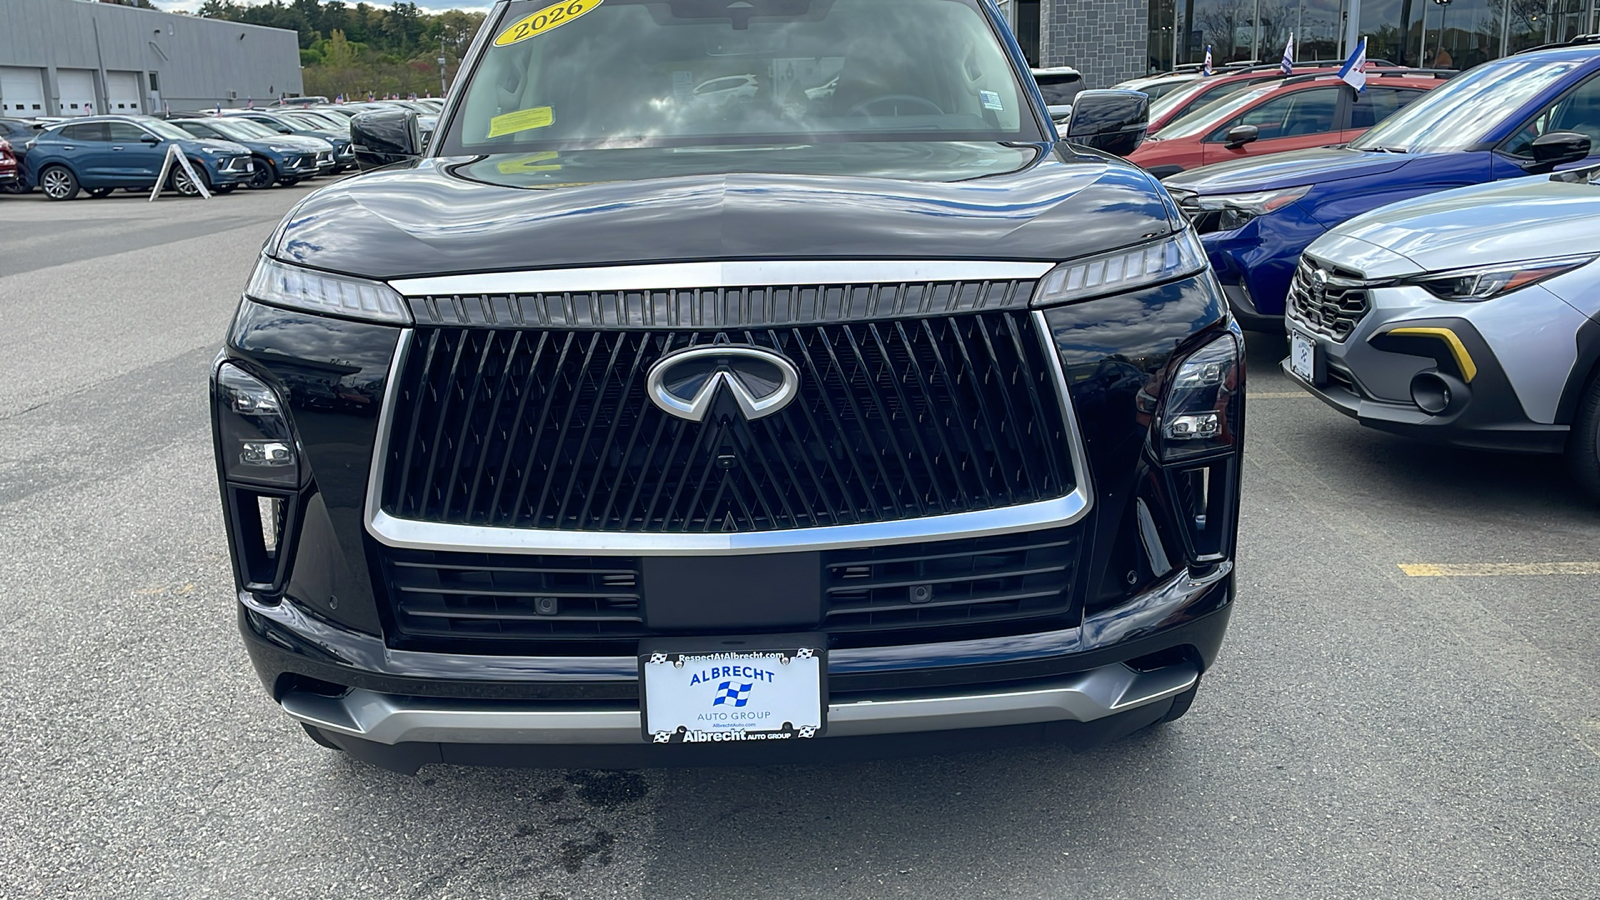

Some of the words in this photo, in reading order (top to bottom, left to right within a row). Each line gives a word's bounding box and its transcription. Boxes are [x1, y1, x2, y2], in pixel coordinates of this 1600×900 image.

[514, 0, 583, 40] 2026
[678, 651, 785, 662] RespectAtAlbrecht.com
[690, 665, 775, 686] ALBRECHT
[697, 712, 728, 721] AUTO
[731, 711, 771, 720] GROUP
[682, 727, 747, 743] Albrecht
[767, 732, 792, 740] GROUP
